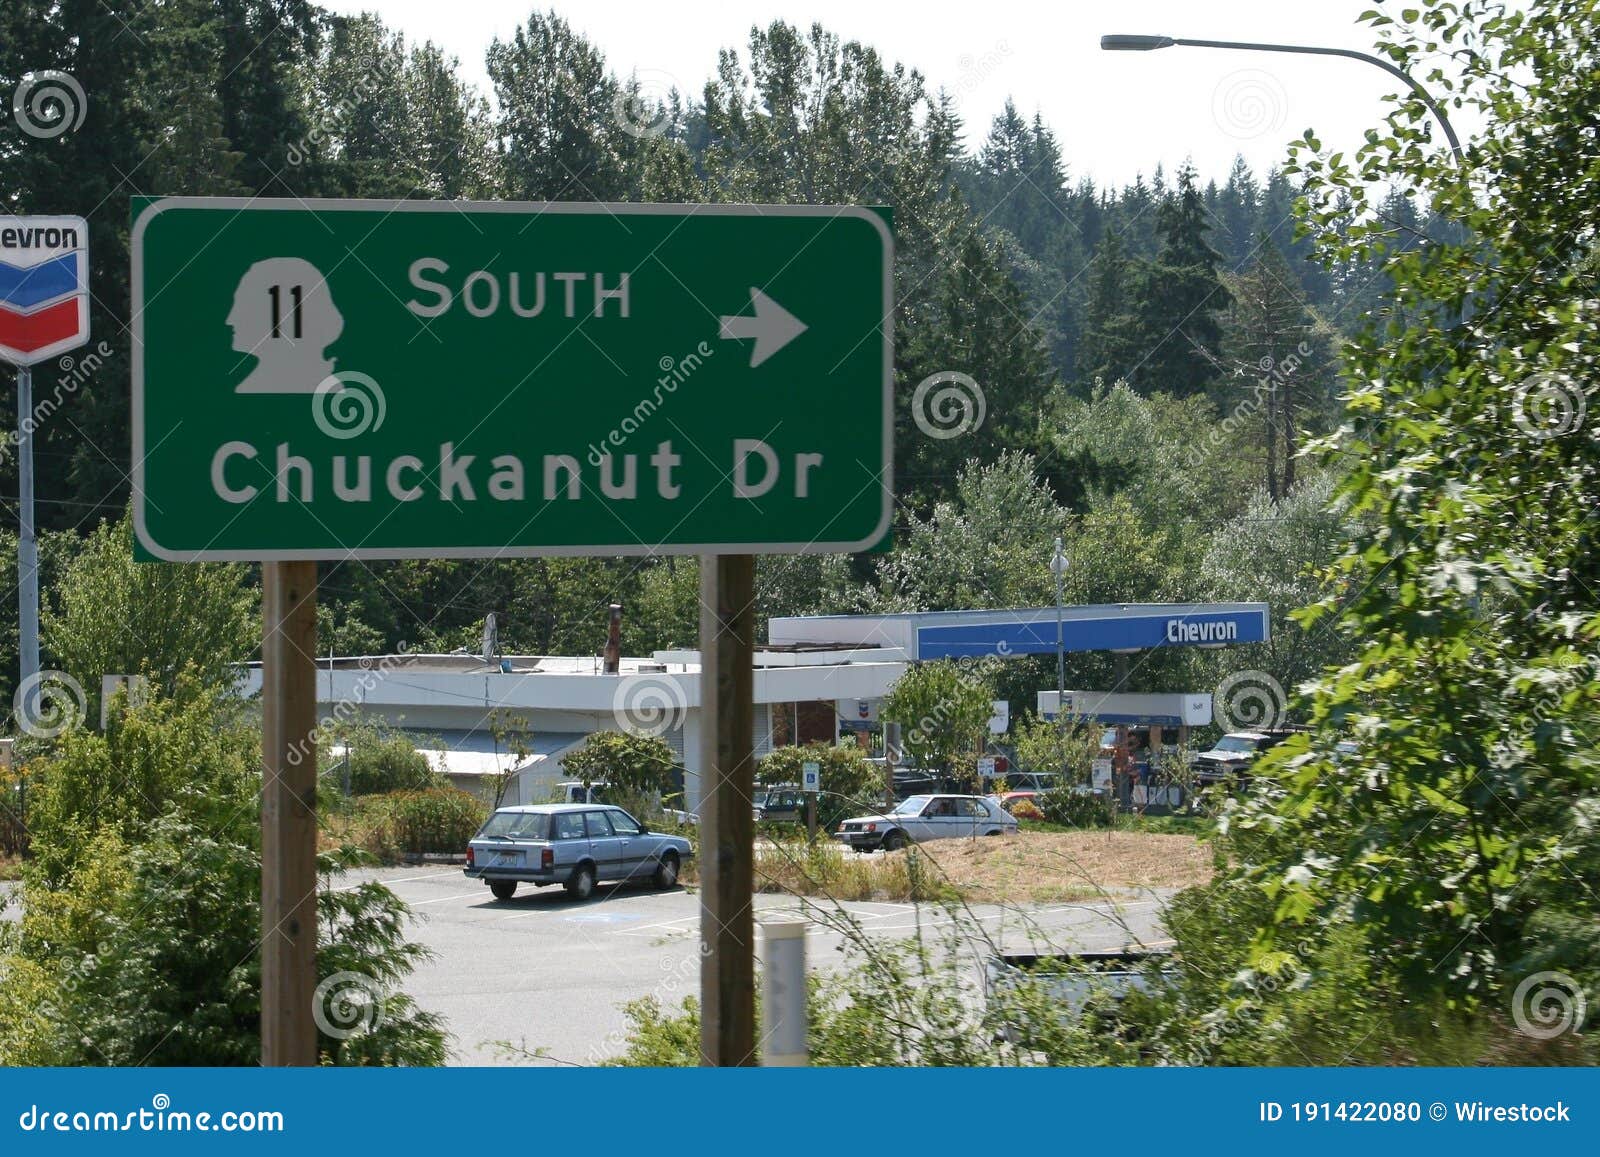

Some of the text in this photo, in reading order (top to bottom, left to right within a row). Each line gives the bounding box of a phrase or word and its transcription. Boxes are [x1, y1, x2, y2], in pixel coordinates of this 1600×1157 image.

[0, 227, 78, 249] evron
[267, 284, 303, 339] 11
[406, 257, 631, 318] SOUTH
[210, 438, 824, 503] Chuckanut Dr
[1167, 620, 1237, 642] Chevron
